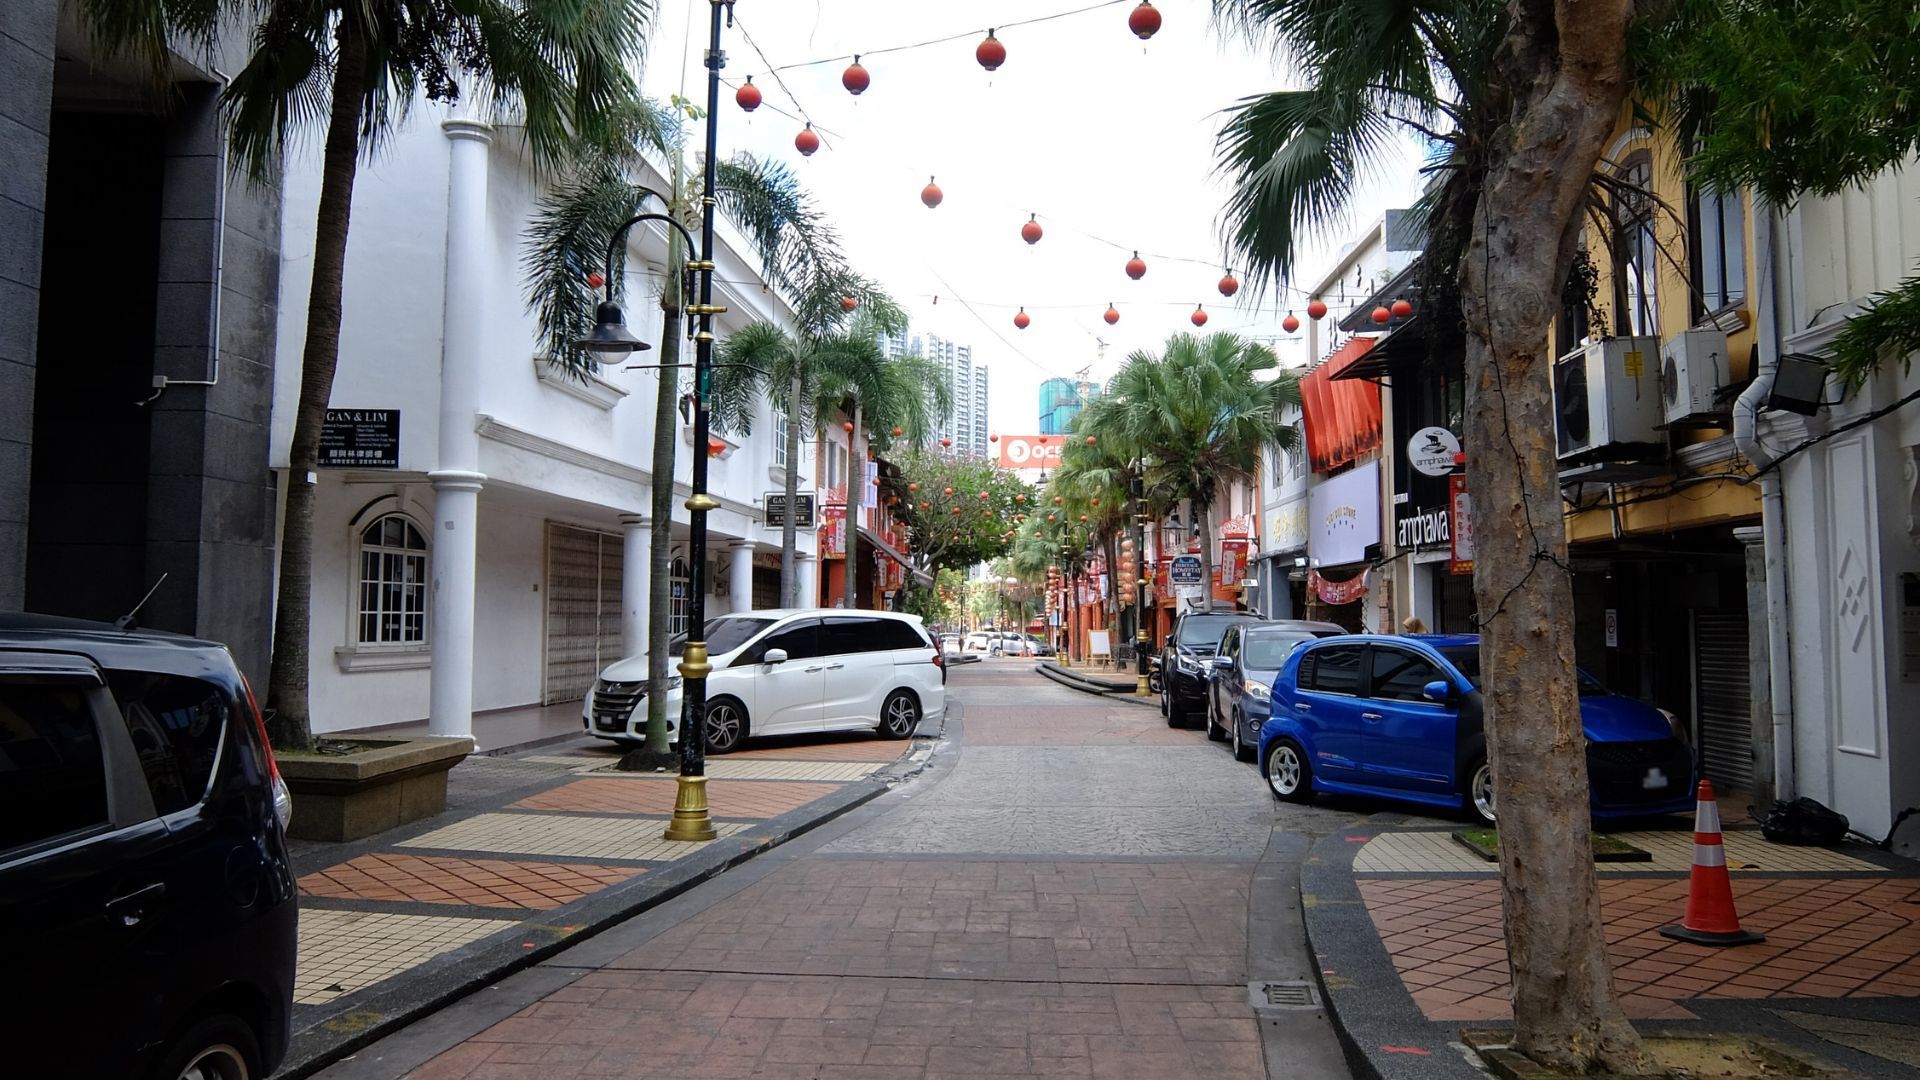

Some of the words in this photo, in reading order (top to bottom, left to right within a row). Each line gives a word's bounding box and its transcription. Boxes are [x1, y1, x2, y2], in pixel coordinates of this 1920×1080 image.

[326, 411, 351, 422] GAN
[353, 412, 362, 422] &
[365, 412, 388, 422] LIM
[1399, 506, 1450, 555] amphawa
